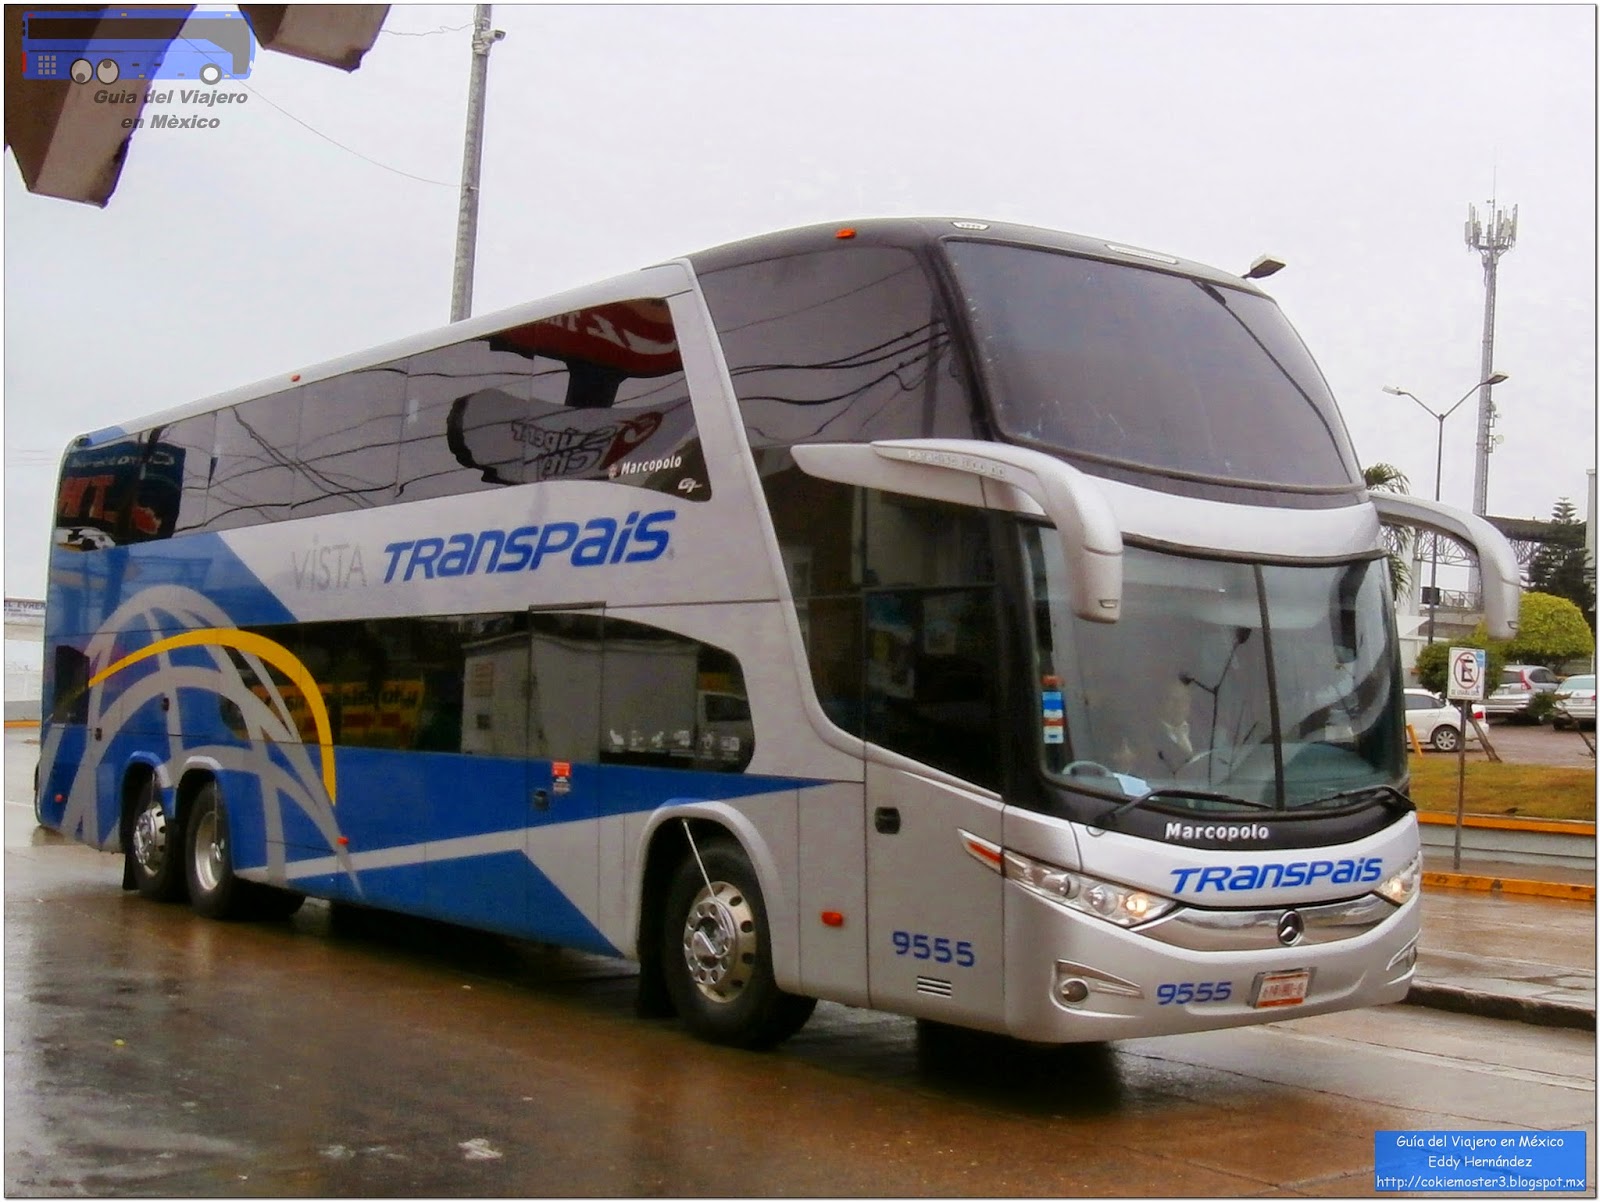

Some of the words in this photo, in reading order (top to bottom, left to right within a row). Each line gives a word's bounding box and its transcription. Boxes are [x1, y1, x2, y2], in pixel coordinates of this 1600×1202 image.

[620, 455, 683, 477] Marcopolo
[1164, 821, 1270, 842] Marcopolo
[892, 930, 976, 968] 9555
[1156, 980, 1233, 1006] 9555
